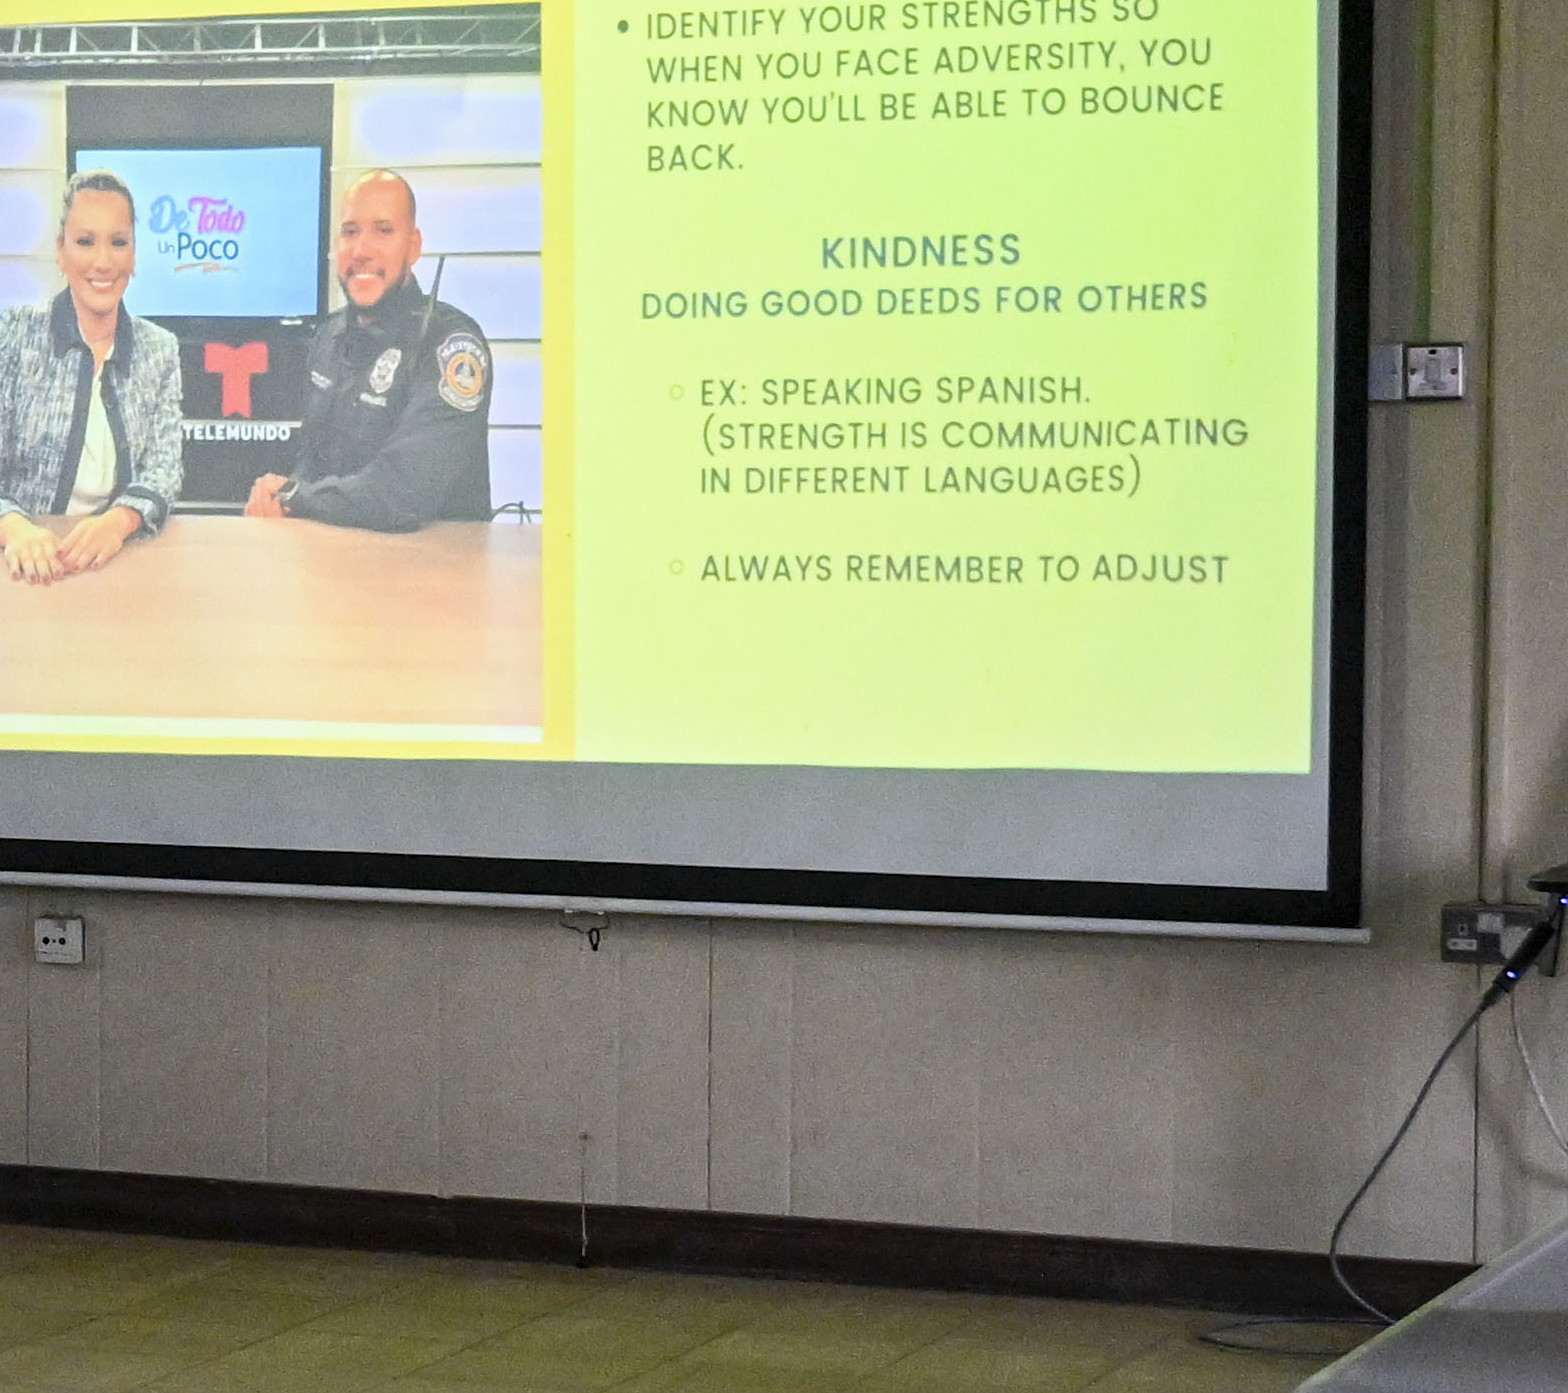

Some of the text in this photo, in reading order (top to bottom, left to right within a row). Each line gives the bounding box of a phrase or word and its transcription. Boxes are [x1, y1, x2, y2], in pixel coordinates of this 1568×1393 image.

[647, 8, 786, 40] IDENTIFY
[799, 3, 886, 34] YOUR
[646, 37, 1211, 84] WHEN YOU FACE ADVERSITY, YOU
[647, 82, 1224, 128] KNOW YOU'LL BE ABLE TO BOUNCE
[647, 143, 746, 172] BACK.
[149, 195, 246, 235] De Todo
[822, 233, 1020, 269] KINDNESS
[641, 281, 1207, 320] DOING GOOD DEEDS FOR OTHERS
[701, 375, 1092, 407] EX: SPEAKING SPANISH.
[182, 424, 291, 442] TELEMUNDO
[703, 412, 1249, 457] (STRENGTH IS COMMUNICATING
[701, 453, 1141, 498] IN DIFFERENT LANGUAGES)
[700, 553, 1229, 584] ALWAYS REMEMBER TO ADJUST
